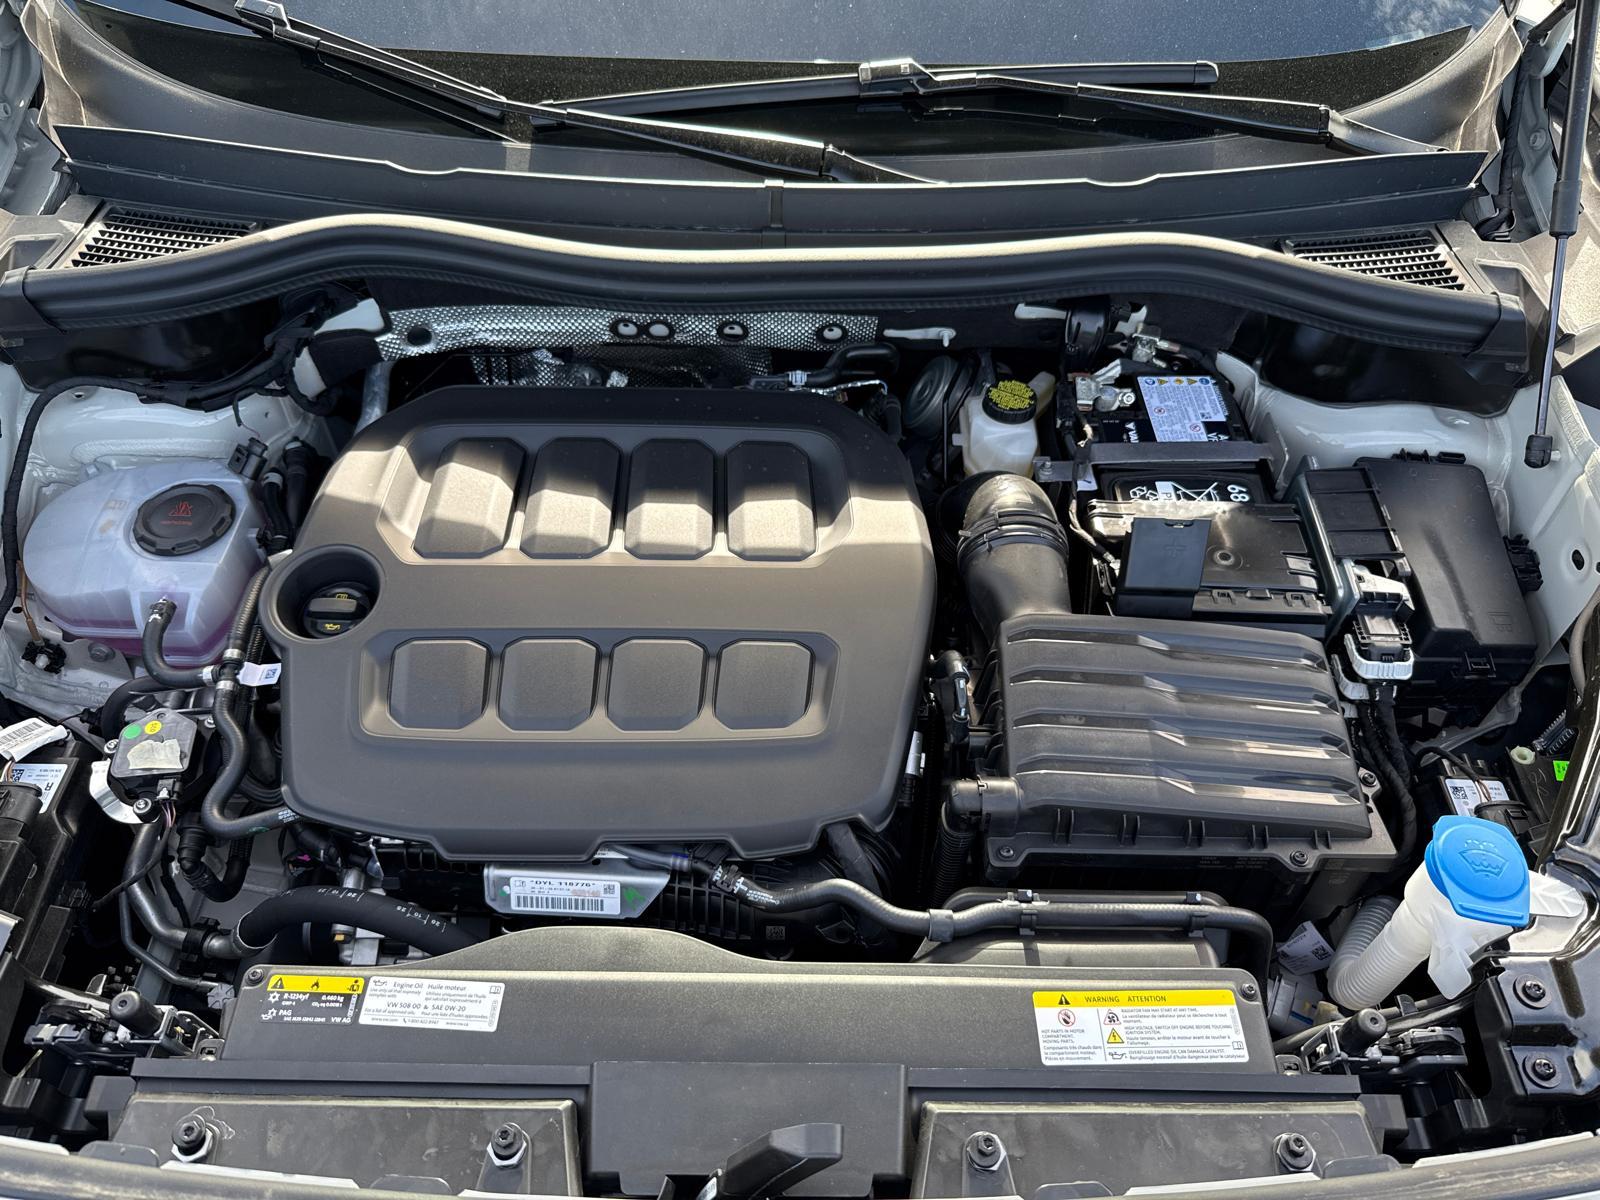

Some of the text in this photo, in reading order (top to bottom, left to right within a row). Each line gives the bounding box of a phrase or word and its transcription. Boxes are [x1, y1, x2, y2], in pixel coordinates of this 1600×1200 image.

[44, 782, 54, 791] R
[431, 919, 441, 927] 20
[283, 993, 310, 1001] R-1234yf
[444, 1004, 466, 1012] 0W-20
